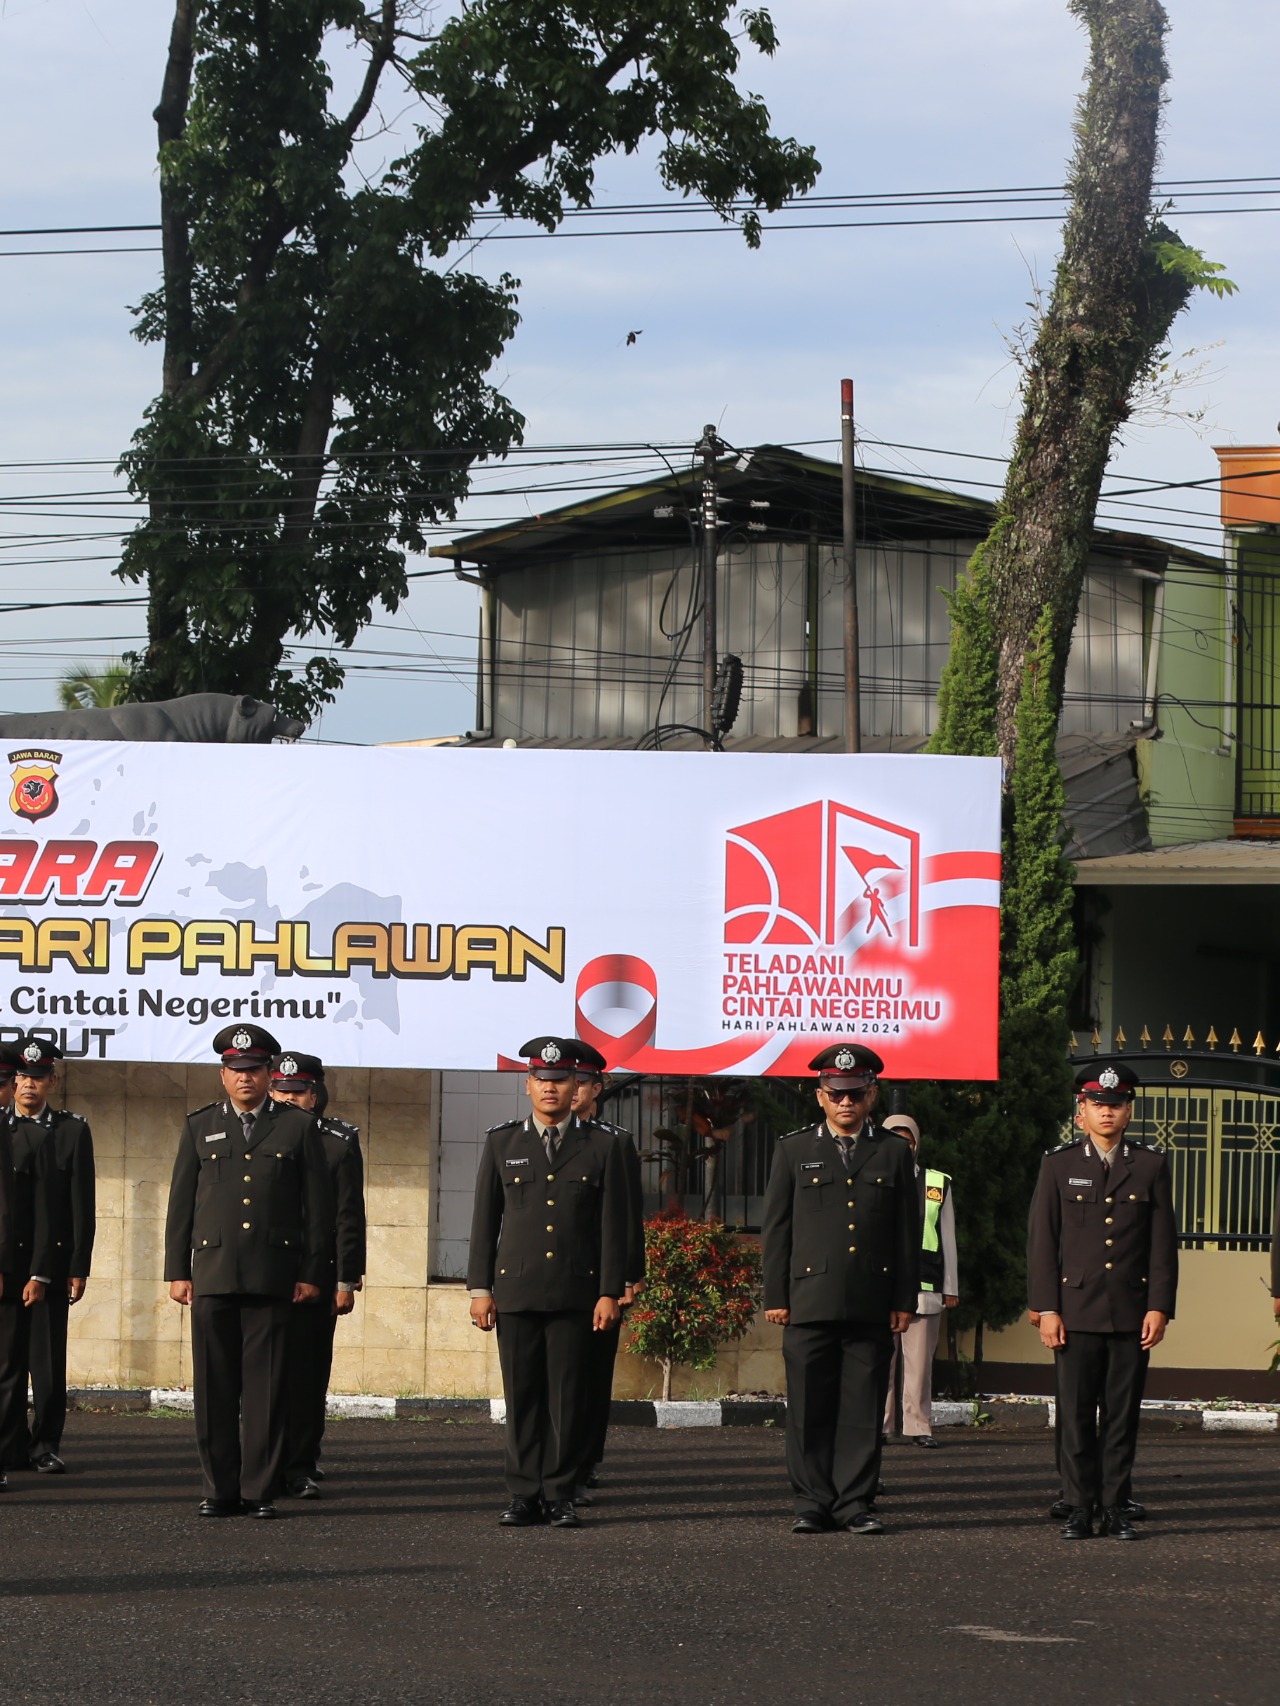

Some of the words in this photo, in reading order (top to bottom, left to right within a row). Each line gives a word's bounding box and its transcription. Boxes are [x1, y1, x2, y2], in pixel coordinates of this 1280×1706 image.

[11, 751, 33, 762] JAWA
[33, 751, 60, 762] BARAT
[126, 918, 565, 982] PAHLAWAN
[723, 953, 845, 975] TELADANI
[722, 975, 903, 998] PAHLAWANMU
[10, 986, 130, 1016] Cintai
[138, 988, 342, 1025] Negerimu"
[722, 996, 802, 1018] CINTAI
[810, 999, 941, 1021] NEGERIMU
[722, 1020, 760, 1031] HARI
[766, 1021, 856, 1033] PAHLAWAN
[861, 1023, 900, 1034] 2024
